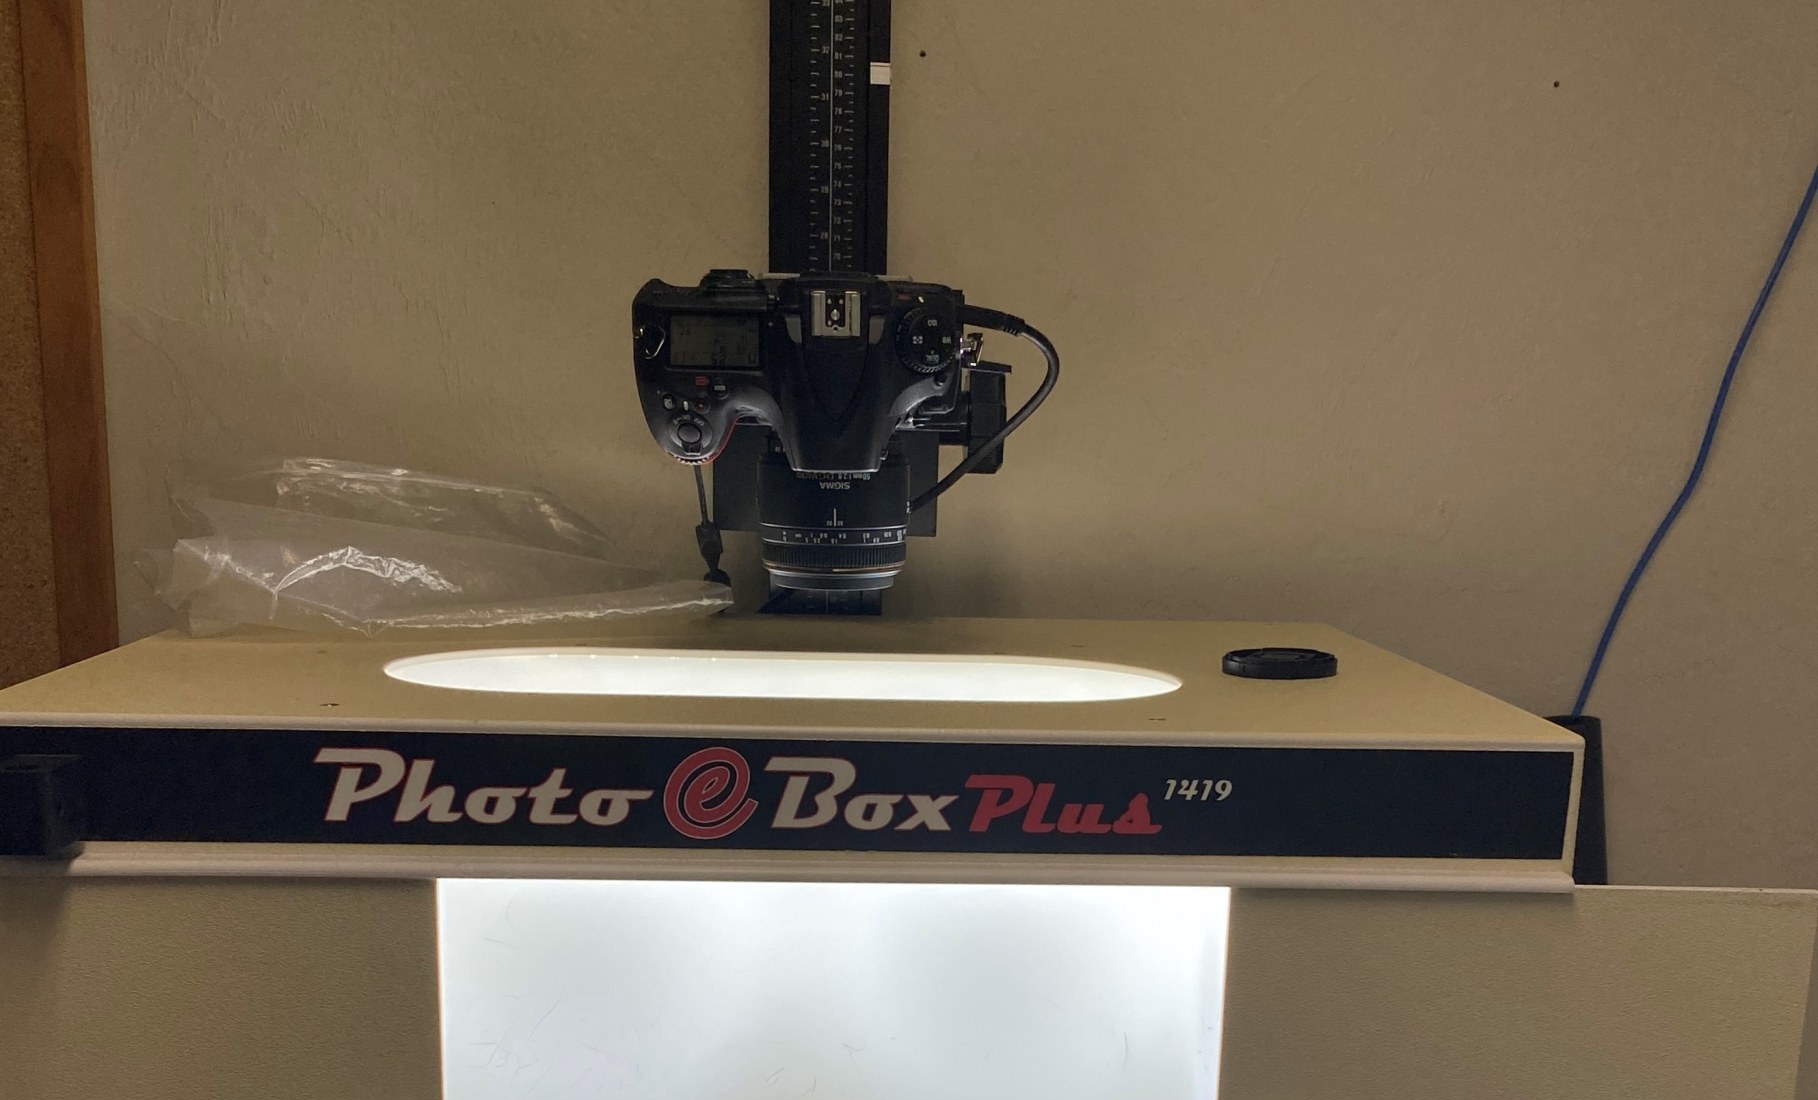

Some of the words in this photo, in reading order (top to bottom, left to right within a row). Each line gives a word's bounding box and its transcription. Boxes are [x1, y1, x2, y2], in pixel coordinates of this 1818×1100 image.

[819, 482, 851, 490] SIGMA
[313, 746, 656, 826] Photo
[763, 755, 959, 832] Box
[964, 773, 1163, 835] Plus
[1164, 779, 1233, 801] 1419
